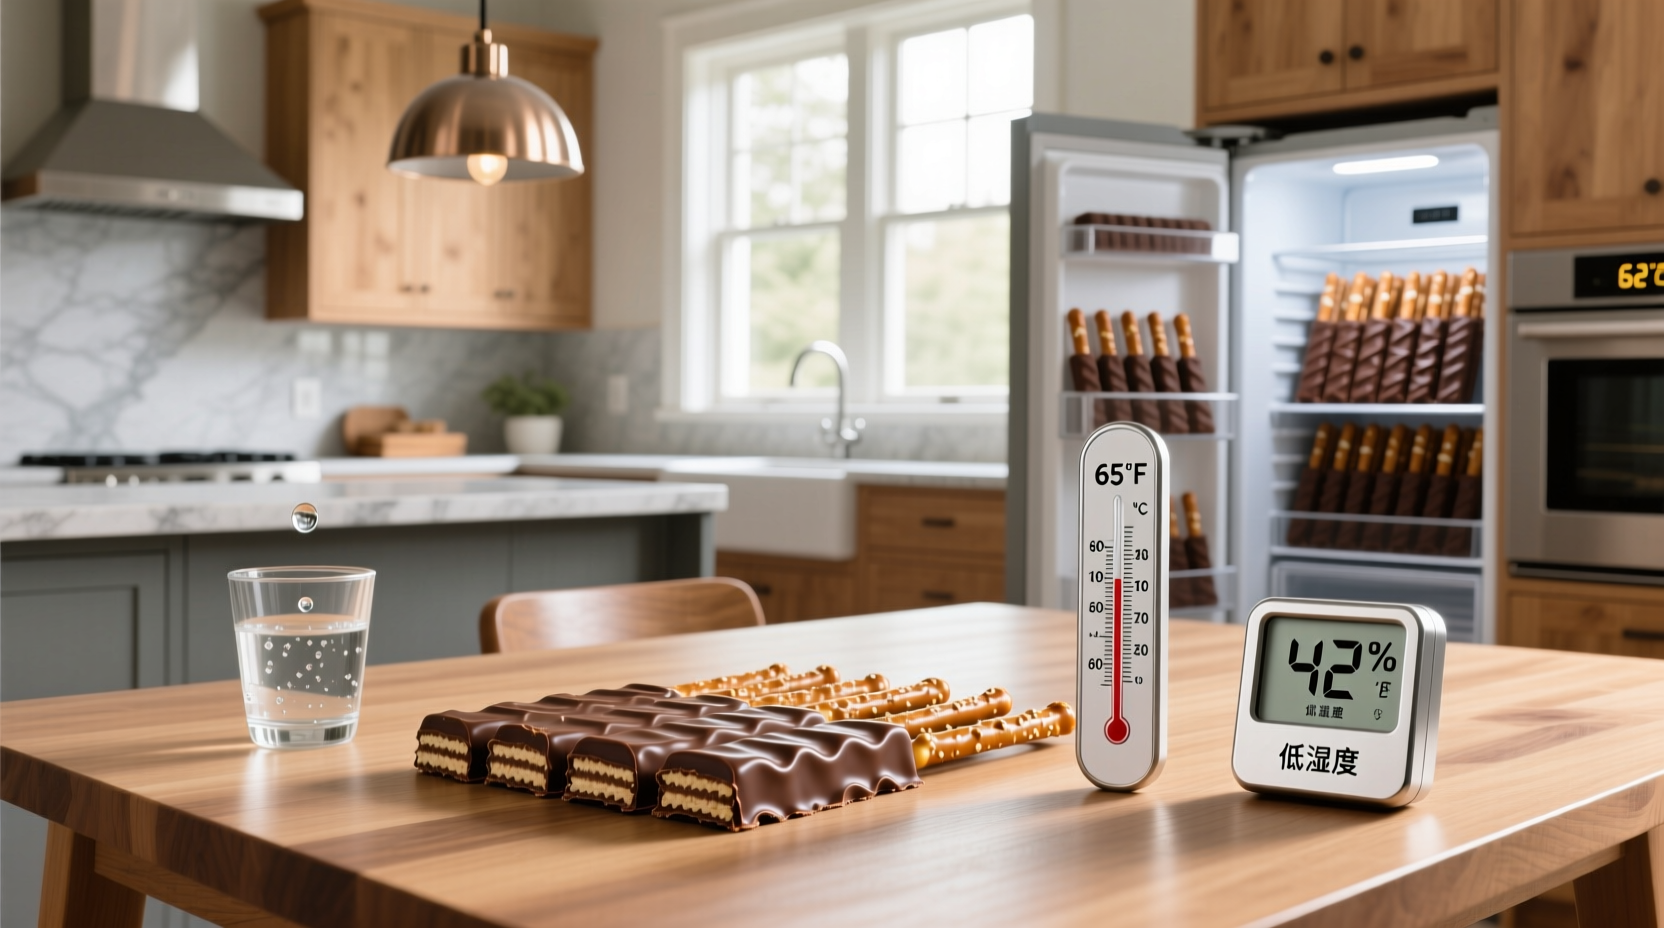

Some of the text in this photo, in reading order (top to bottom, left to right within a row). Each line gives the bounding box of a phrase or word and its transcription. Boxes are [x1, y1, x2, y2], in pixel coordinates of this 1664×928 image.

[1094, 463, 1148, 486] 65°F
[1089, 571, 1104, 583] 10
[1134, 580, 1149, 592] 10
[1089, 601, 1104, 613] 60
[1088, 658, 1103, 670] 60
[1279, 742, 1360, 776] 低湿度
